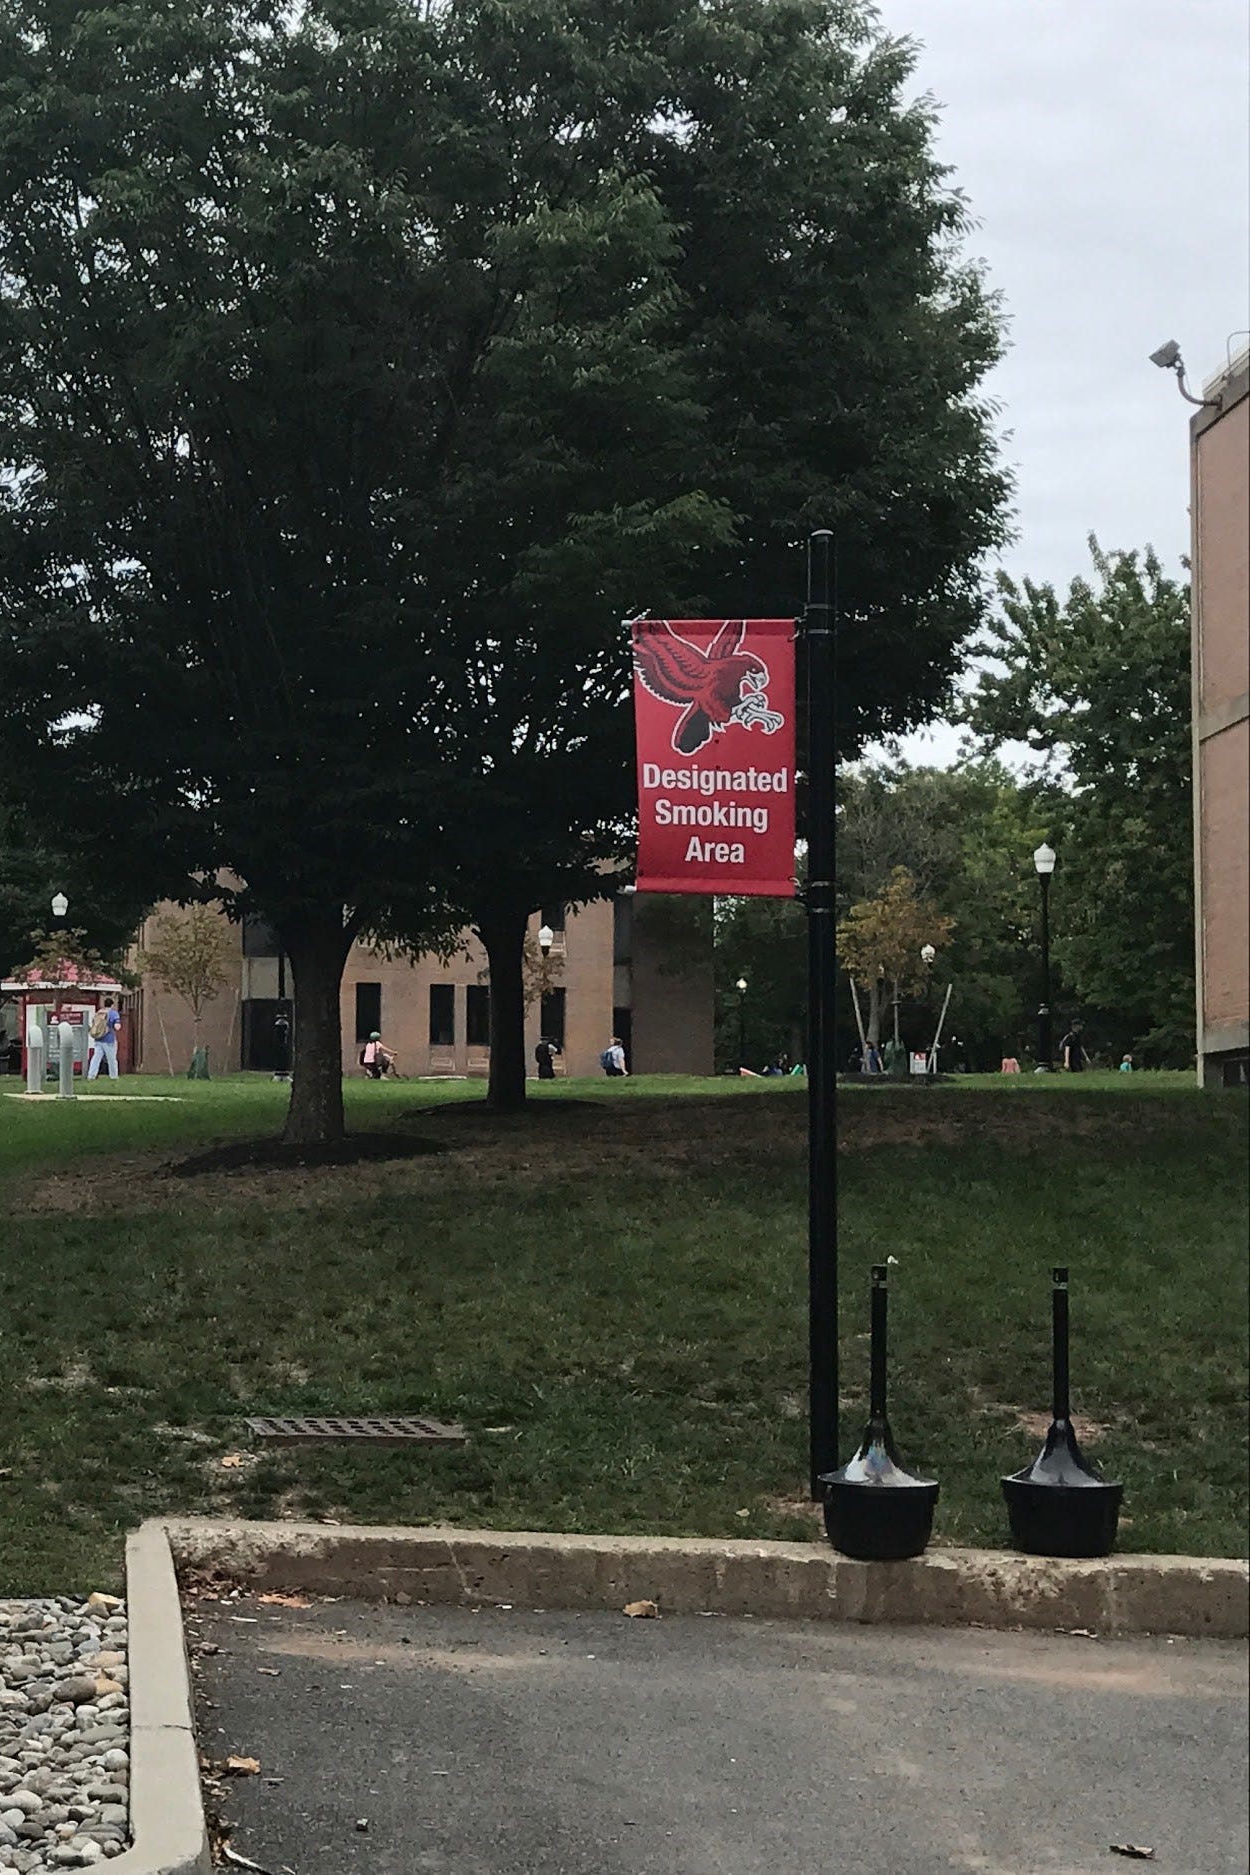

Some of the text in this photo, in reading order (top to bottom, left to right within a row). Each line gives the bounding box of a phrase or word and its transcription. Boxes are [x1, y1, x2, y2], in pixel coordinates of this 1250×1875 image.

[643, 763, 788, 796] Designated
[655, 799, 769, 833] Smoking
[685, 836, 746, 864] Area
